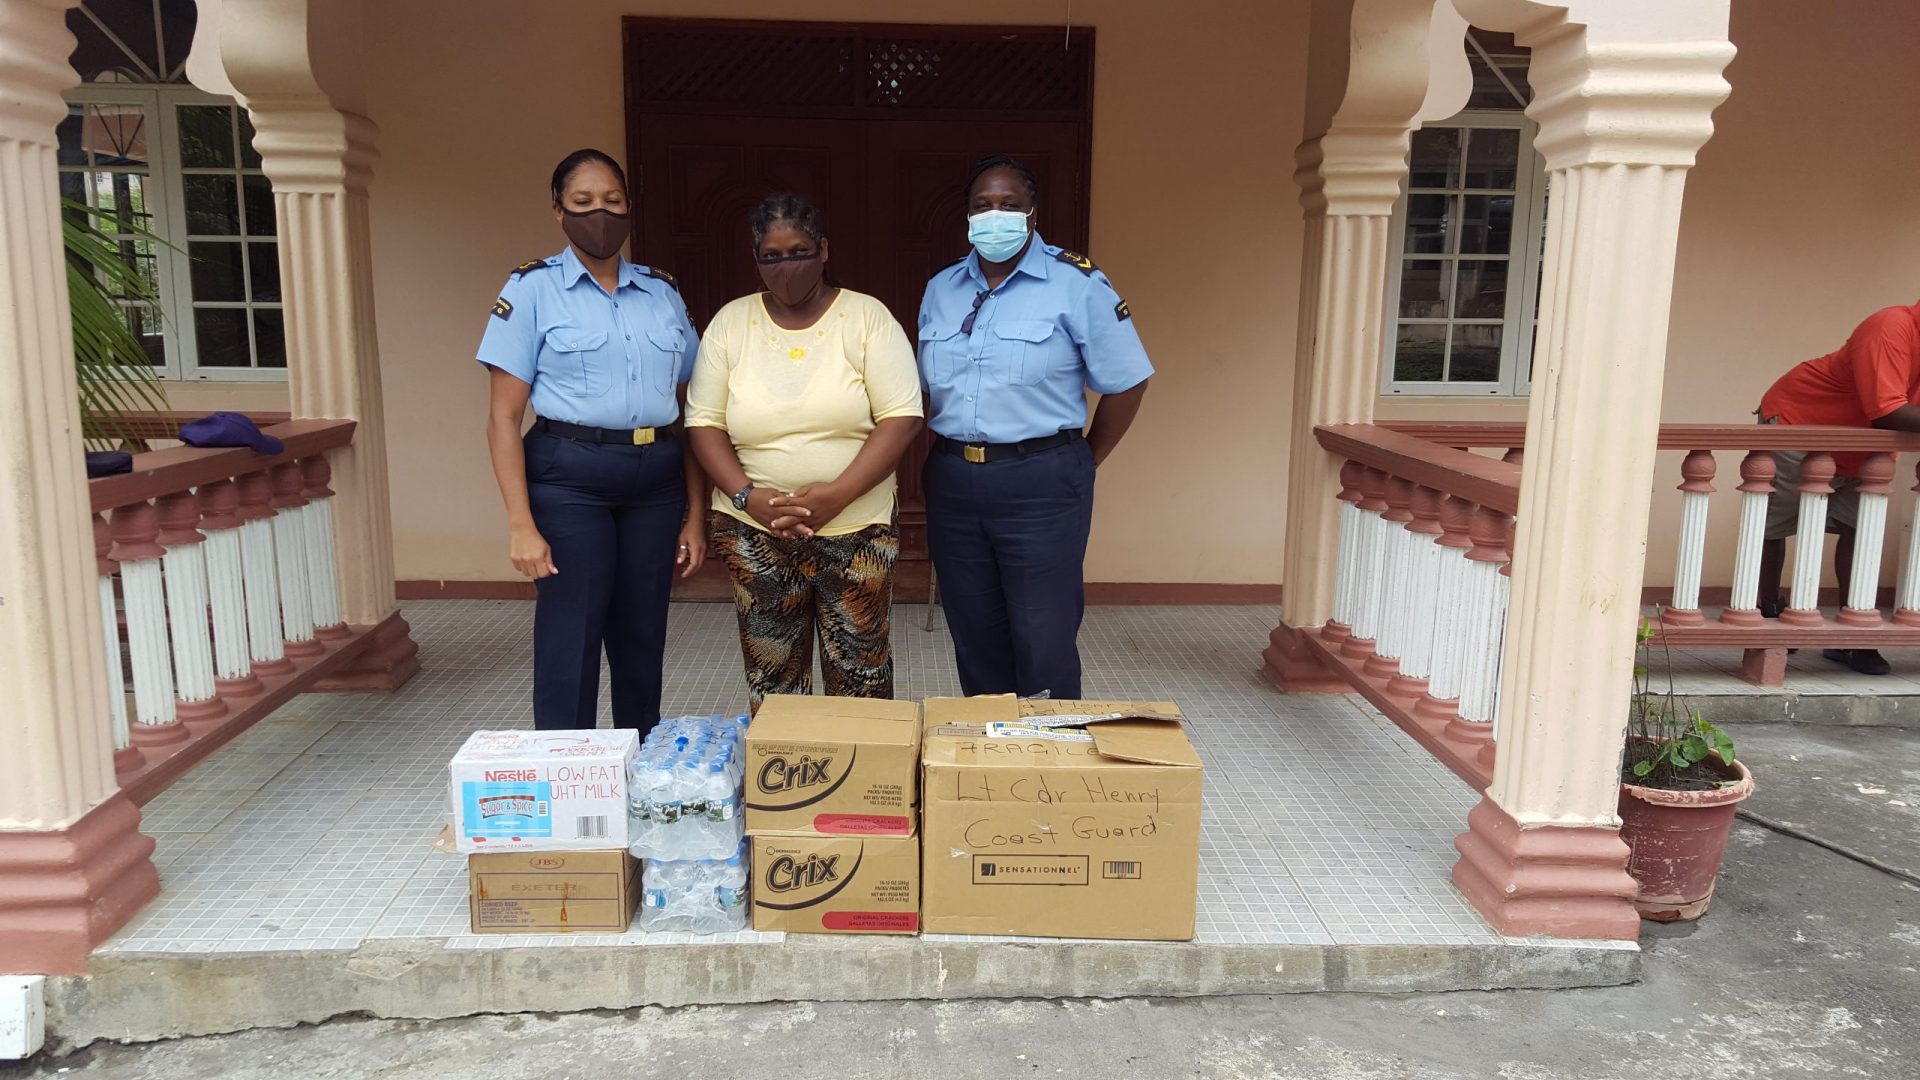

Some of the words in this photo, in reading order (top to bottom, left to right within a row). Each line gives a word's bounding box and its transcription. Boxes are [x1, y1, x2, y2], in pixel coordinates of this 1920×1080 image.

[546, 766, 585, 782] LOW
[590, 765, 620, 781] FAT
[757, 755, 833, 794] Crix
[550, 784, 580, 800] UHT
[584, 783, 621, 800] MILK
[957, 771, 996, 801] Lt
[1010, 774, 1067, 805] Cdr
[1081, 775, 1160, 813] Henry
[481, 801, 504, 816] Sugar
[964, 818, 1059, 849] Coast
[1071, 814, 1157, 840] Guard
[535, 858, 559, 866] JBS
[999, 865, 1080, 875] SENSATIONNEL
[766, 853, 841, 893] Crix
[511, 884, 577, 892] EXETER
